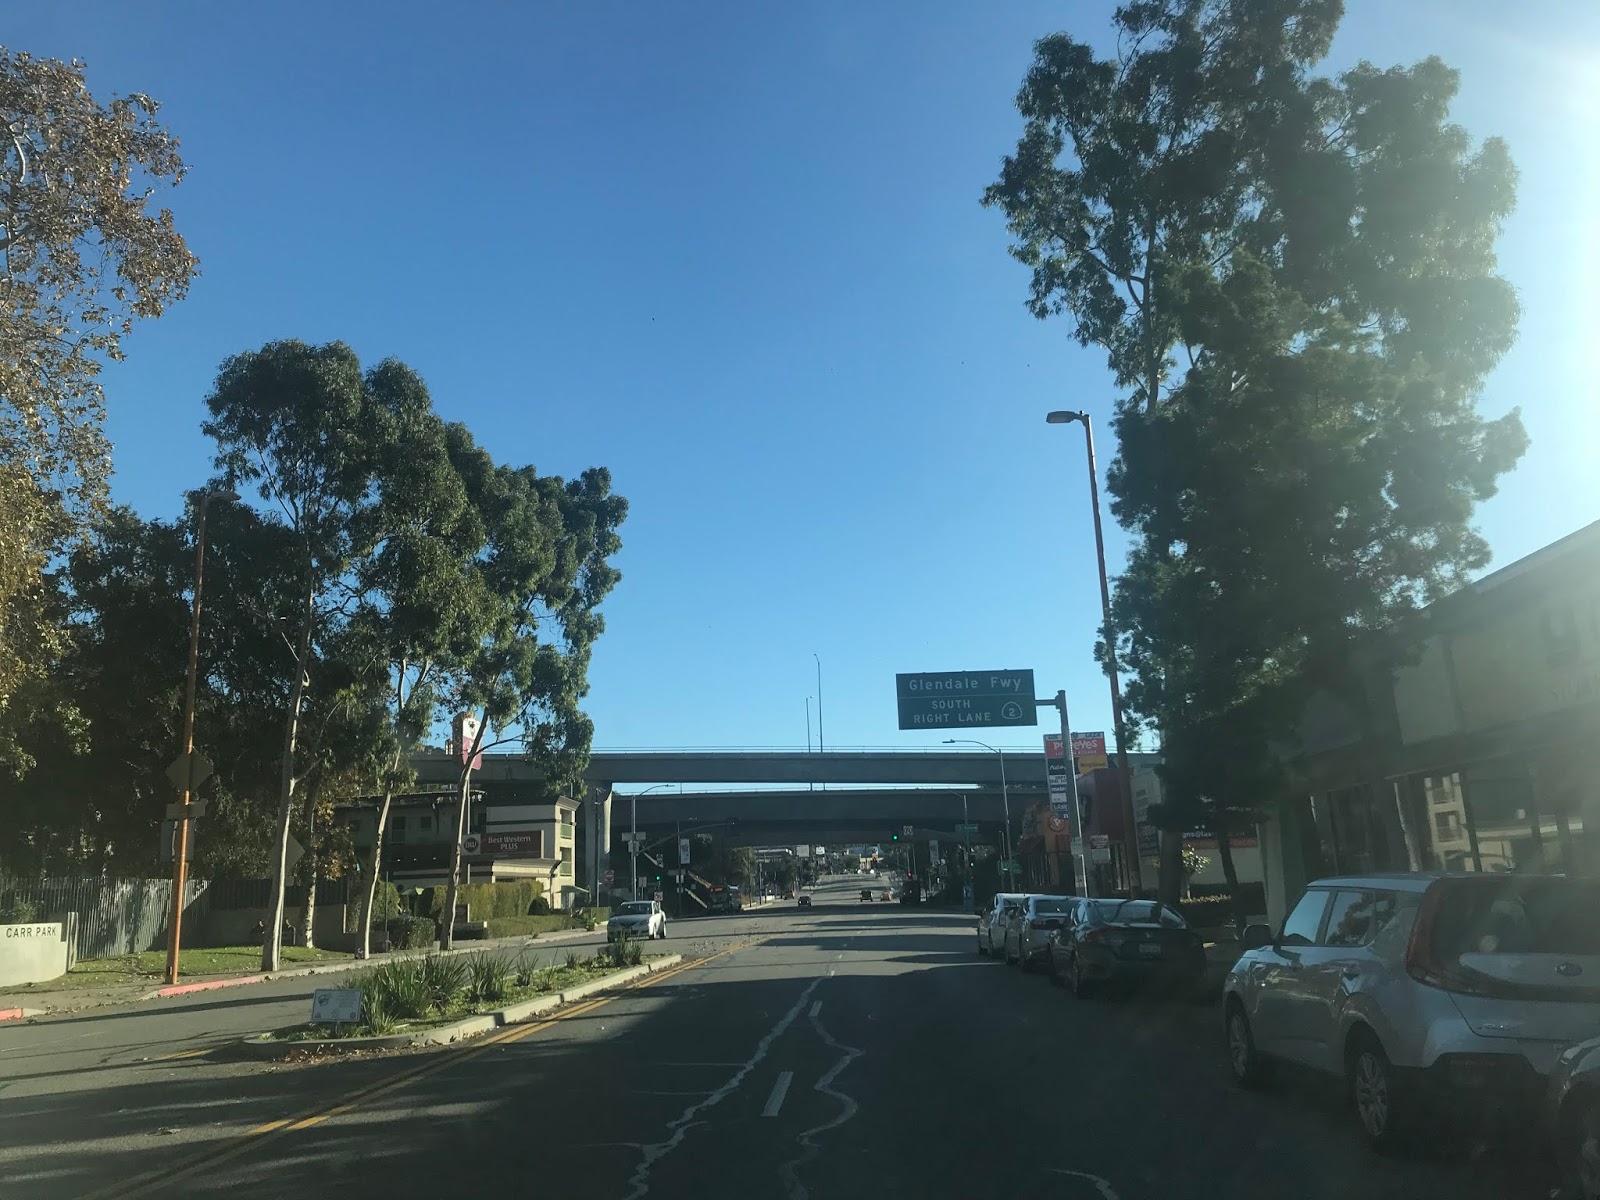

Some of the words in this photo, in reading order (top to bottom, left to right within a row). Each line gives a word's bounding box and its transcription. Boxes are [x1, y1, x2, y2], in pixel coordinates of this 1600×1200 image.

[909, 678, 978, 690] Glendale
[990, 677, 1021, 691] Fwy
[931, 700, 971, 709] SOUTH
[913, 713, 950, 723] RIGHT
[958, 712, 992, 722] LANE
[1008, 708, 1016, 717] 2
[488, 836, 503, 844] Best
[6, 927, 32, 938] CARR
[36, 926, 56, 937] PARK
